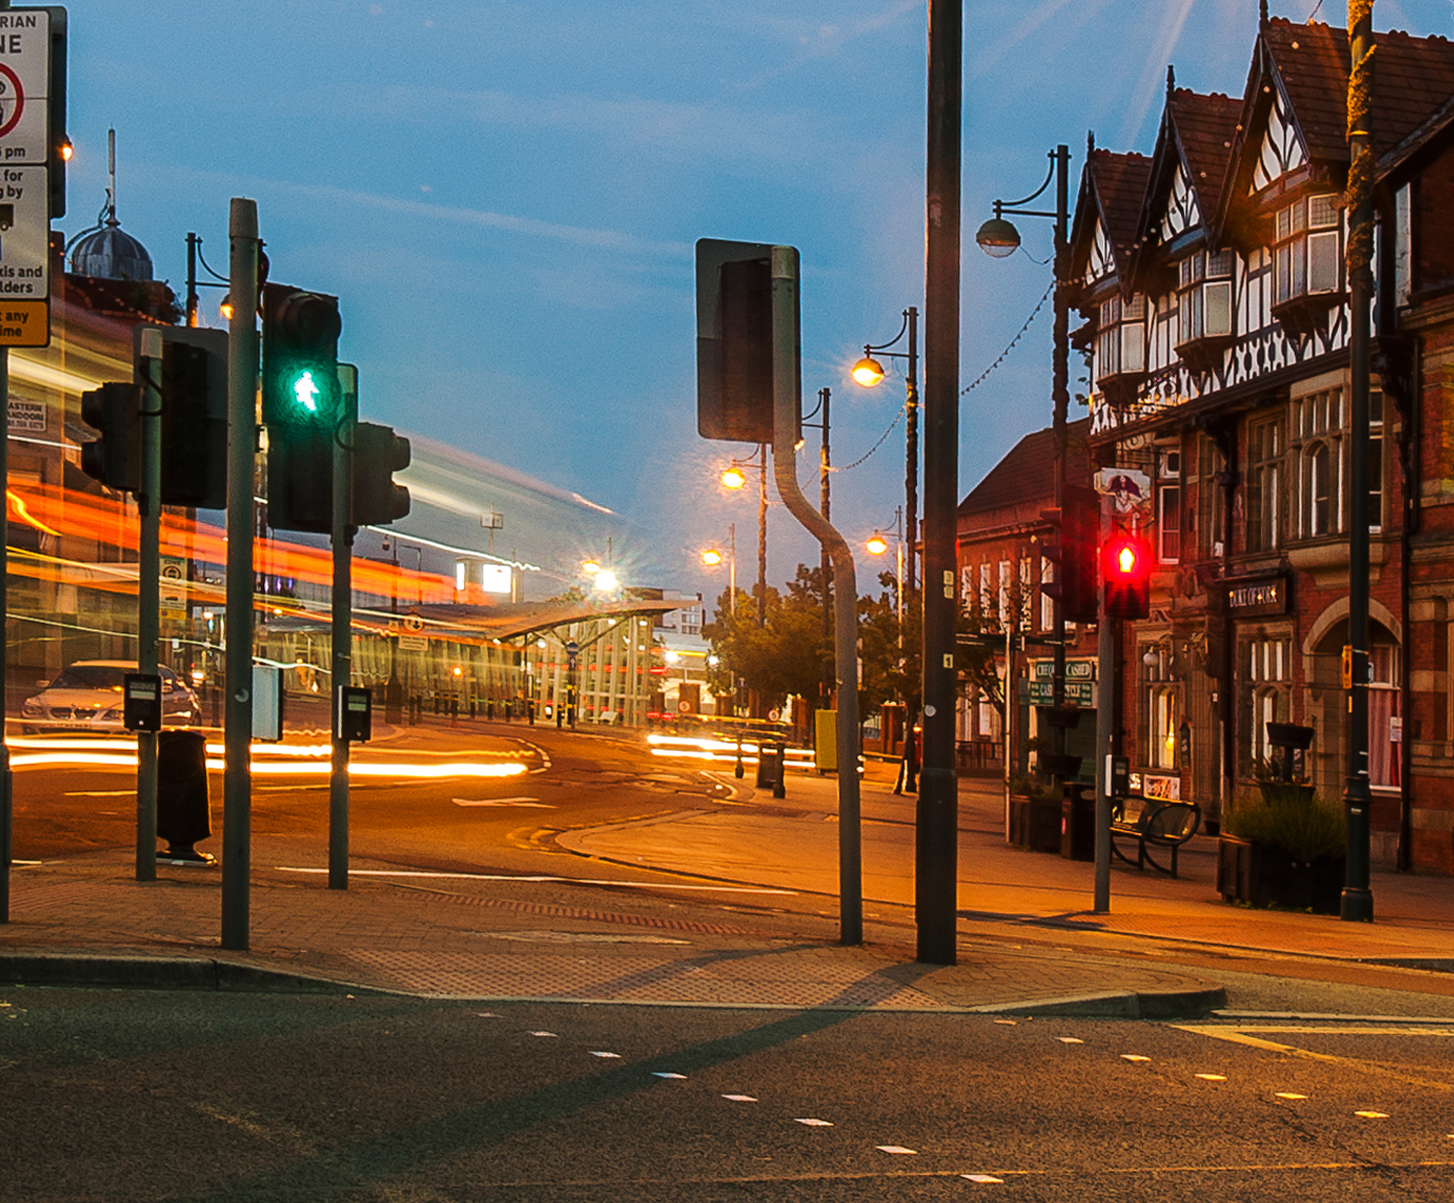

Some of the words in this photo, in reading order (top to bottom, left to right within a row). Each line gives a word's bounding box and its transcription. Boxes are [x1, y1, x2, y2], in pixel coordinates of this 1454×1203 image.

[5, 147, 26, 159] pm
[3, 169, 23, 181] for
[7, 185, 23, 199] by
[17, 265, 43, 277] and
[5, 312, 29, 324] any
[8, 402, 42, 412] ASTERN
